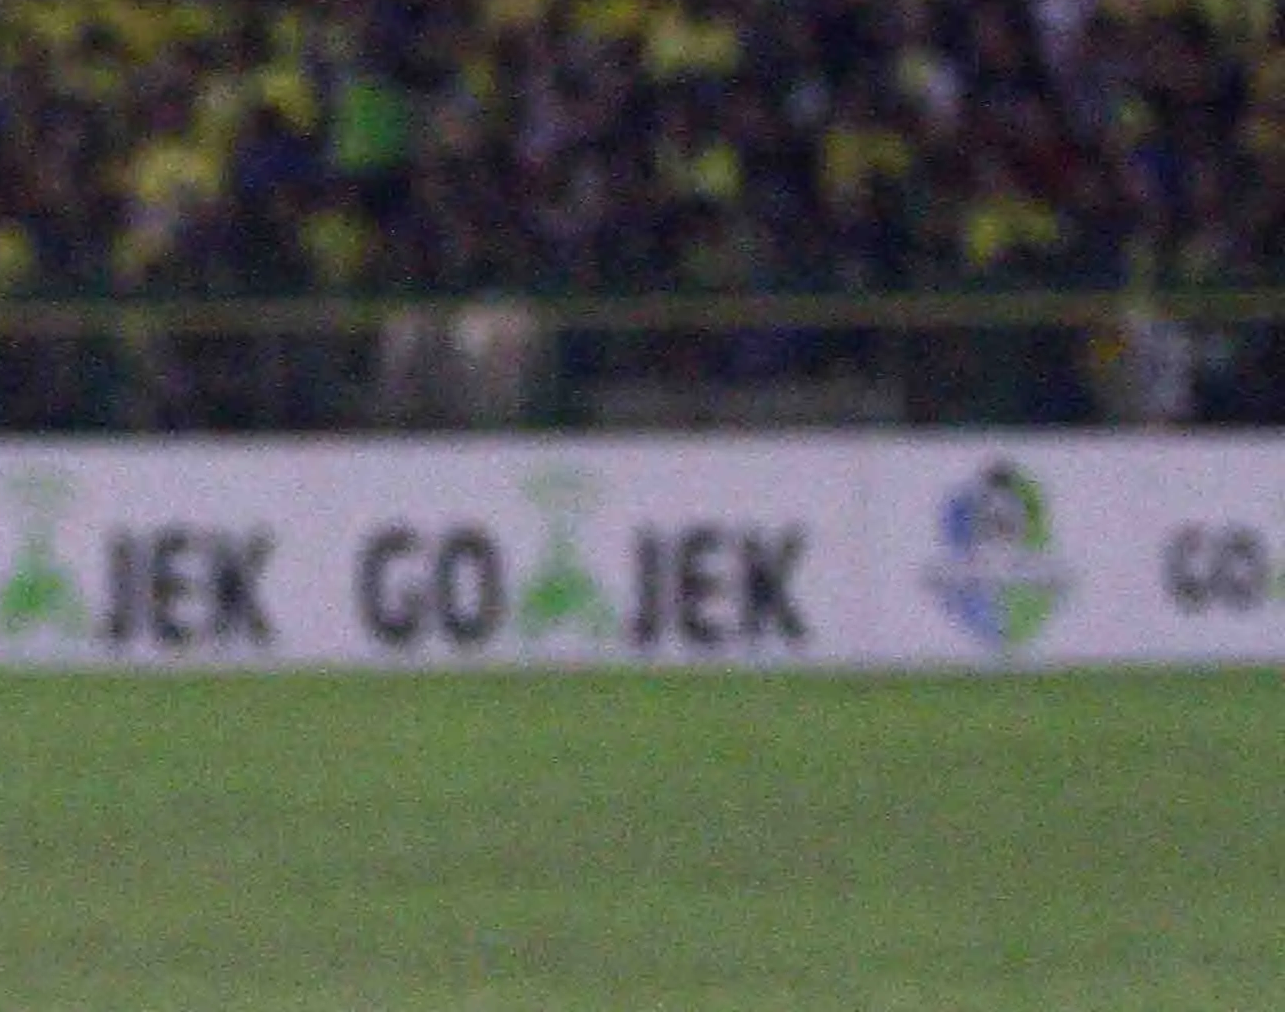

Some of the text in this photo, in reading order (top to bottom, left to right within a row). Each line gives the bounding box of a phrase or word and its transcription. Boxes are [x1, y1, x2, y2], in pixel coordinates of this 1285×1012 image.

[101, 523, 277, 648] JEK
[355, 520, 809, 648] GO JEK
[1160, 523, 1272, 615] GO
